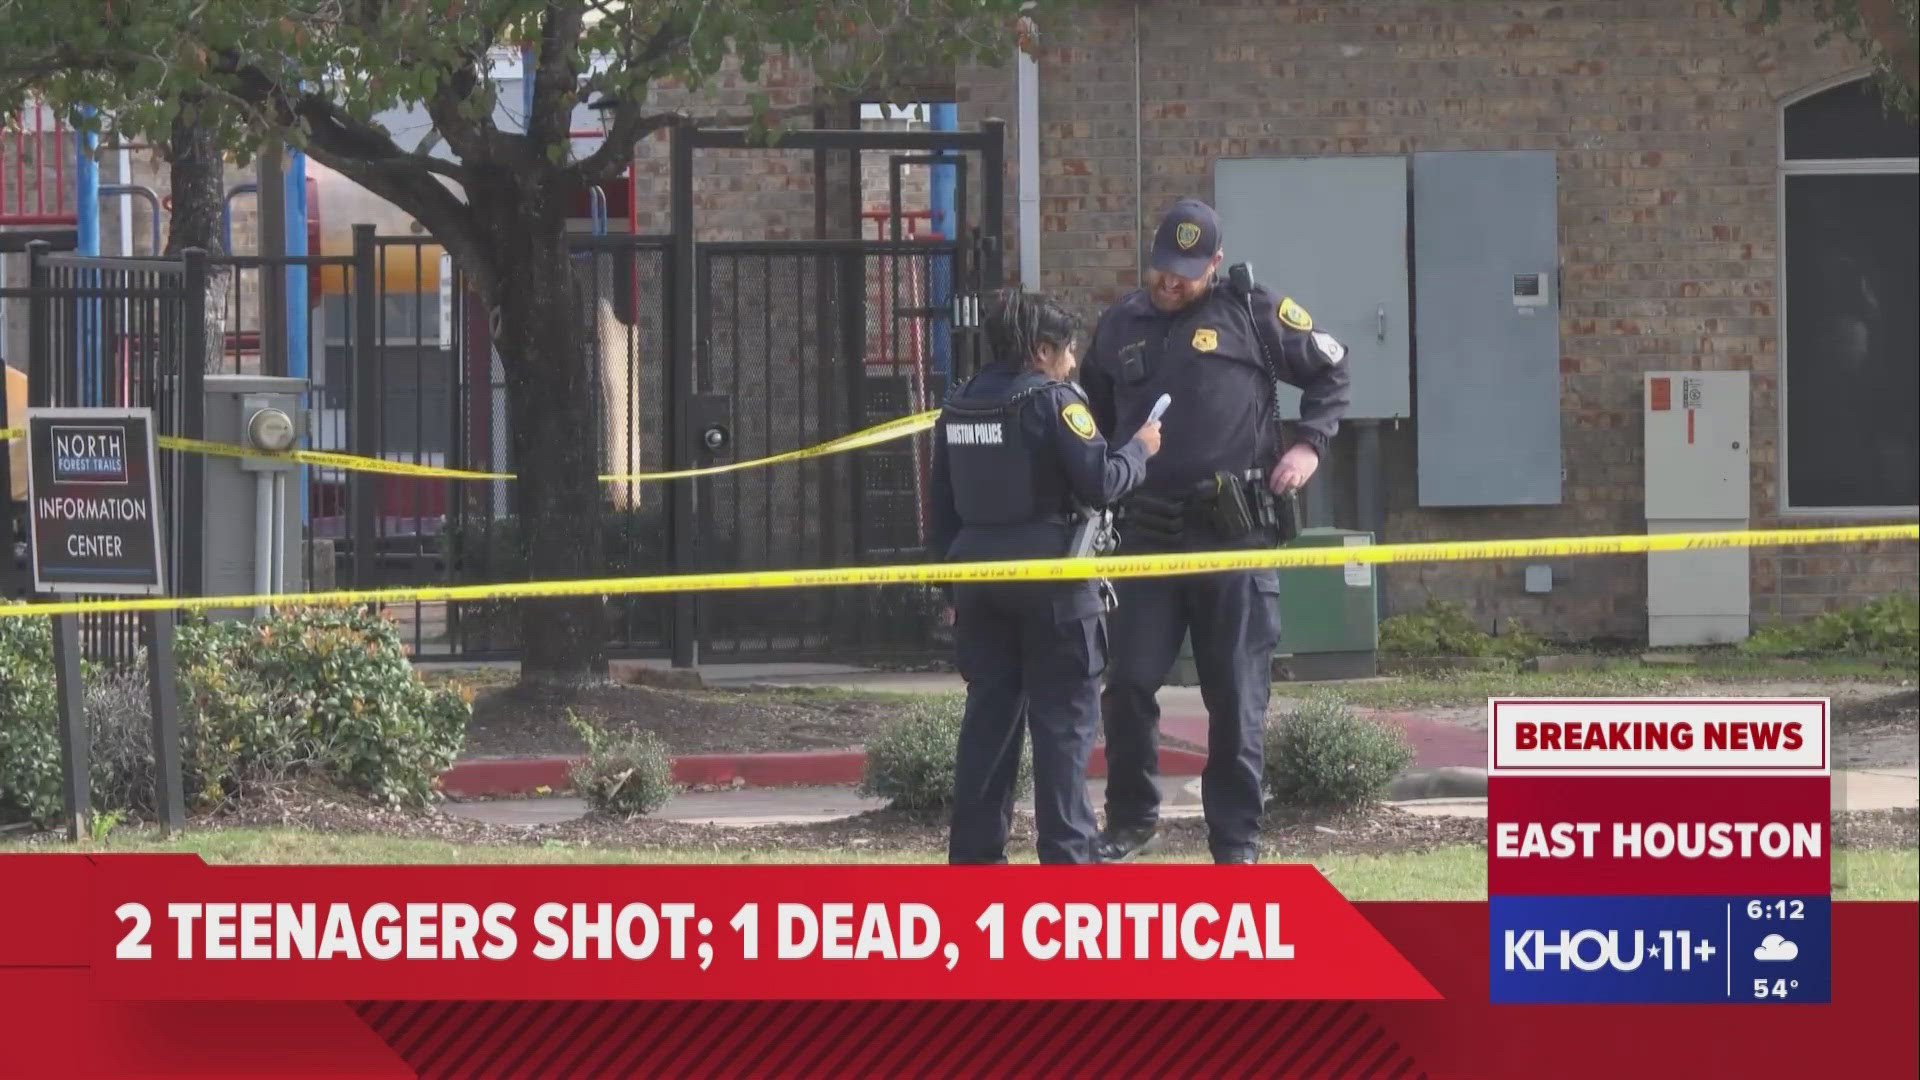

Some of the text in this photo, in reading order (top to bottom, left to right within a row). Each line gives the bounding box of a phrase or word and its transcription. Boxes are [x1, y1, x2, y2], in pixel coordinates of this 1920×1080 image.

[974, 422, 1003, 444] POLICE
[56, 434, 120, 457] NORTH
[58, 458, 122, 472] FOREST TRAILS
[39, 497, 146, 520] INFORMATION
[67, 534, 122, 557] CENTER
